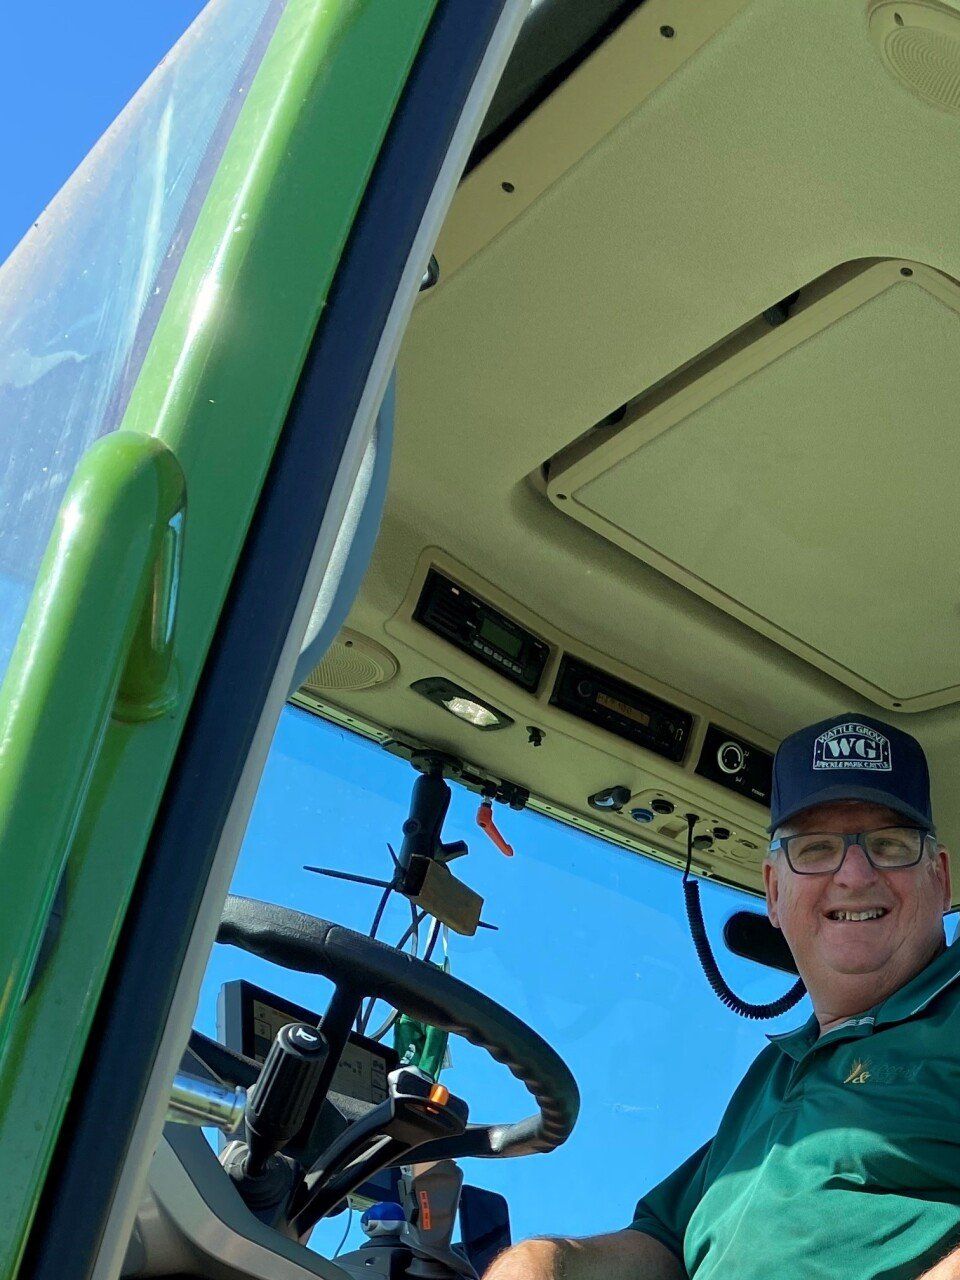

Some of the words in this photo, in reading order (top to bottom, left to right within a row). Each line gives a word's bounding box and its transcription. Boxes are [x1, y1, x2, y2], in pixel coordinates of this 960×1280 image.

[818, 725, 854, 744] WATTLE
[856, 726, 886, 745] GROVE
[827, 738, 876, 758] WG
